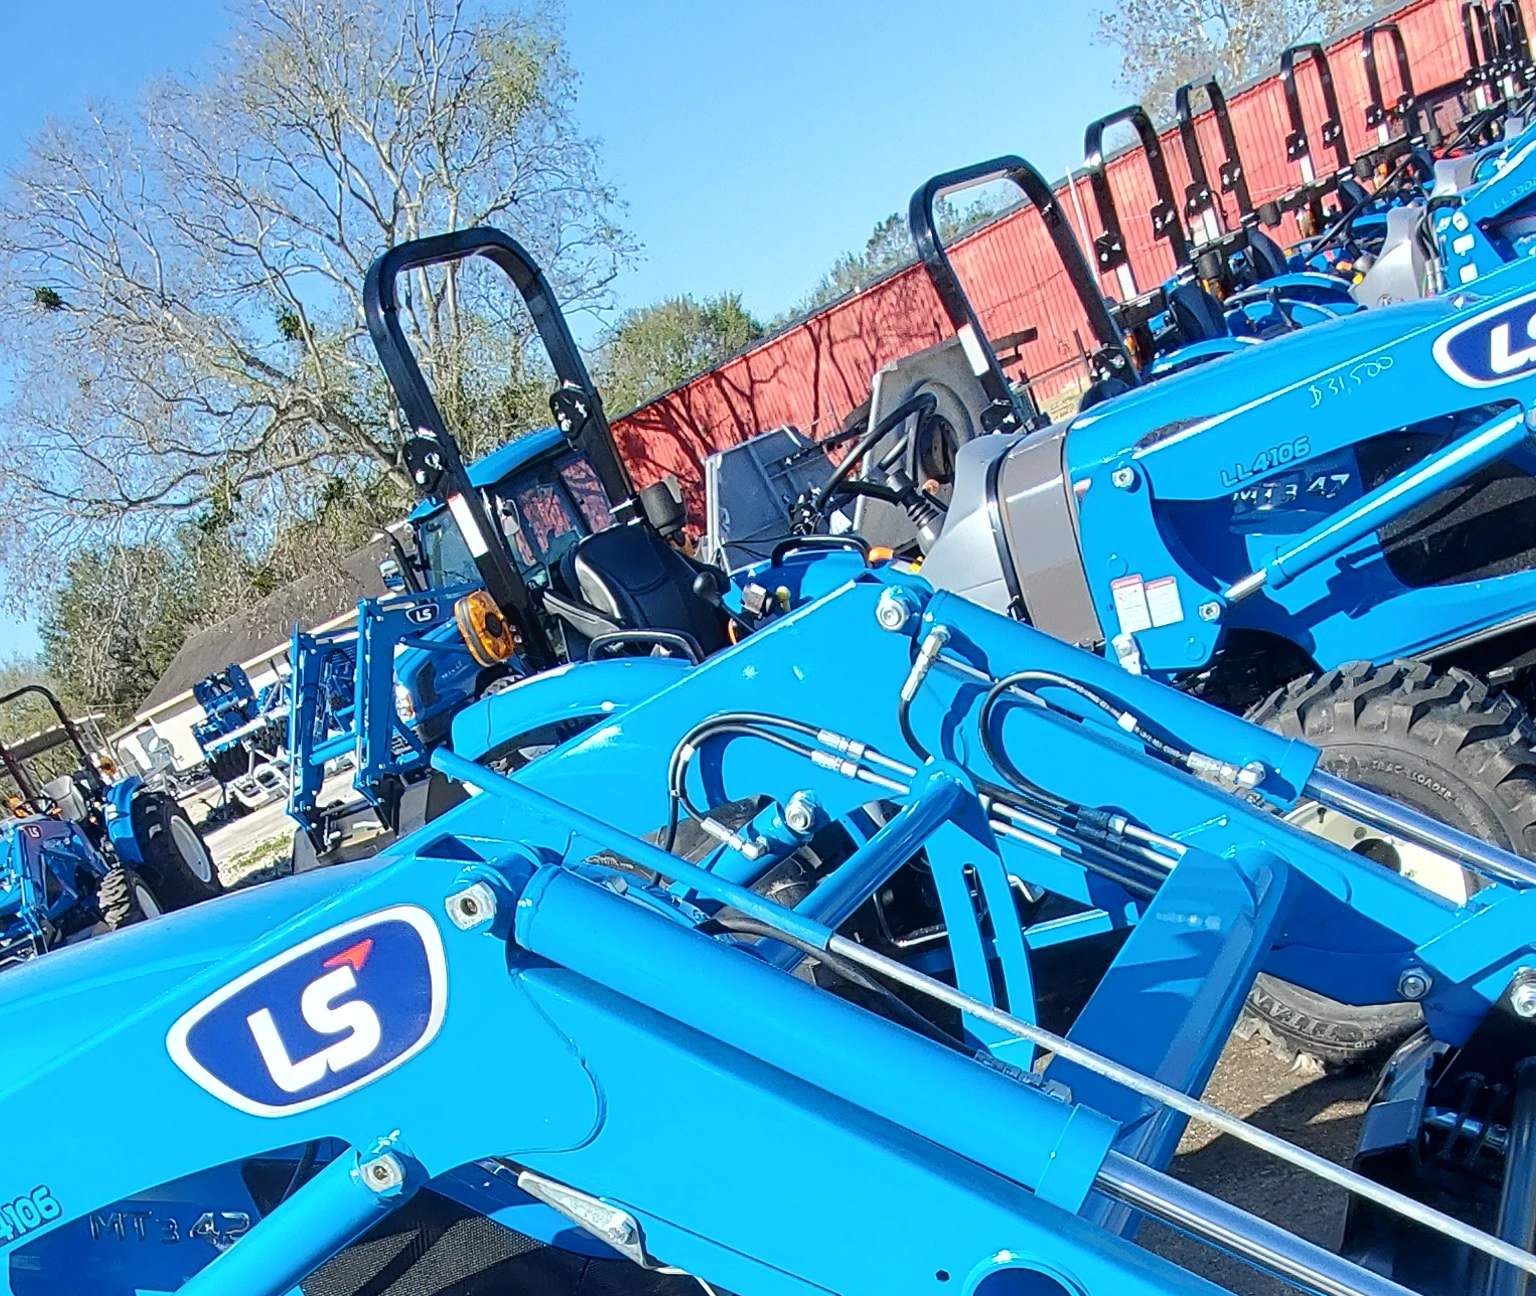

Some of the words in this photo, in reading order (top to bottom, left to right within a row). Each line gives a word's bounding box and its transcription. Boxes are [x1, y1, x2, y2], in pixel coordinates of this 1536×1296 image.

[1308, 356, 1394, 409] $31,500
[1220, 436, 1311, 487] LL4106
[416, 608, 432, 622] LS
[246, 964, 381, 1093] LS
[1249, 986, 1339, 1041] TITAN
